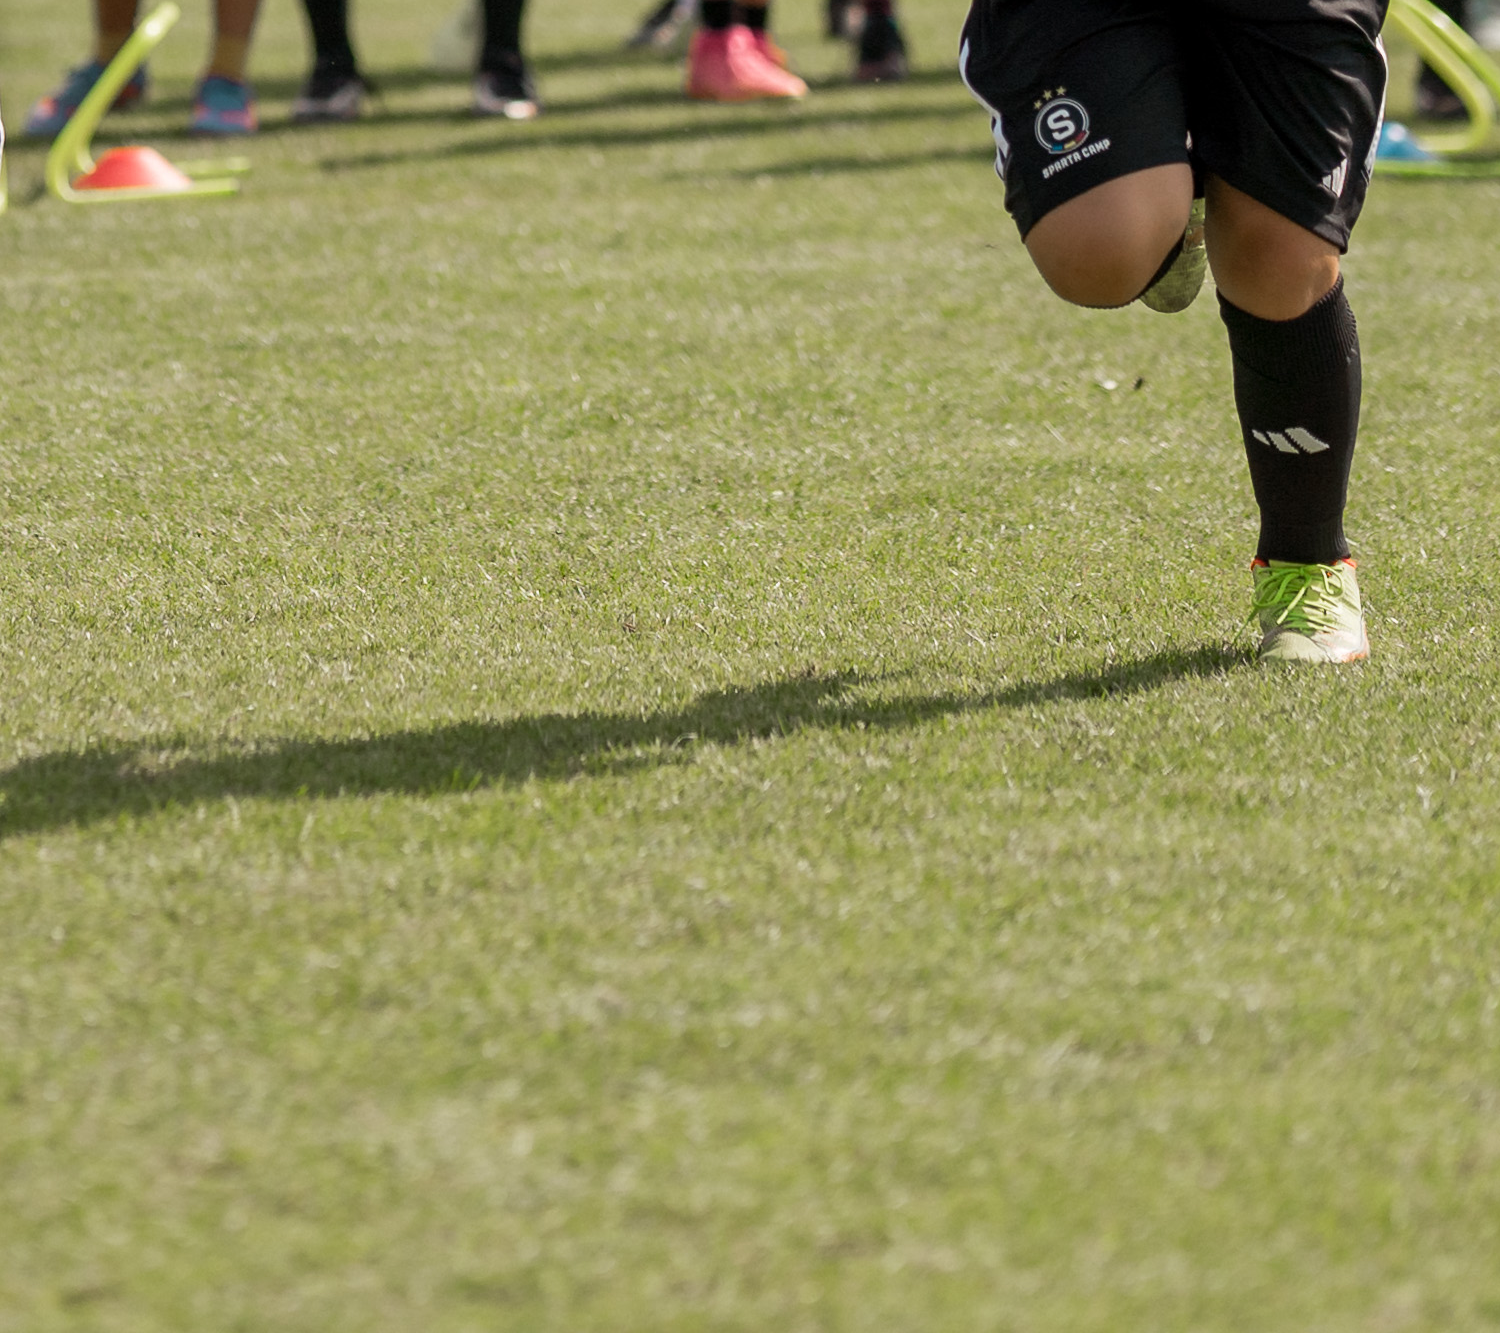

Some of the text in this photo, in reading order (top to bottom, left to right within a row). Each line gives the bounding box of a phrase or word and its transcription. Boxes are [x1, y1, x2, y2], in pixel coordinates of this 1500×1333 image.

[1047, 109, 1076, 141] S
[1042, 138, 1111, 179] SPARTA CAMP
